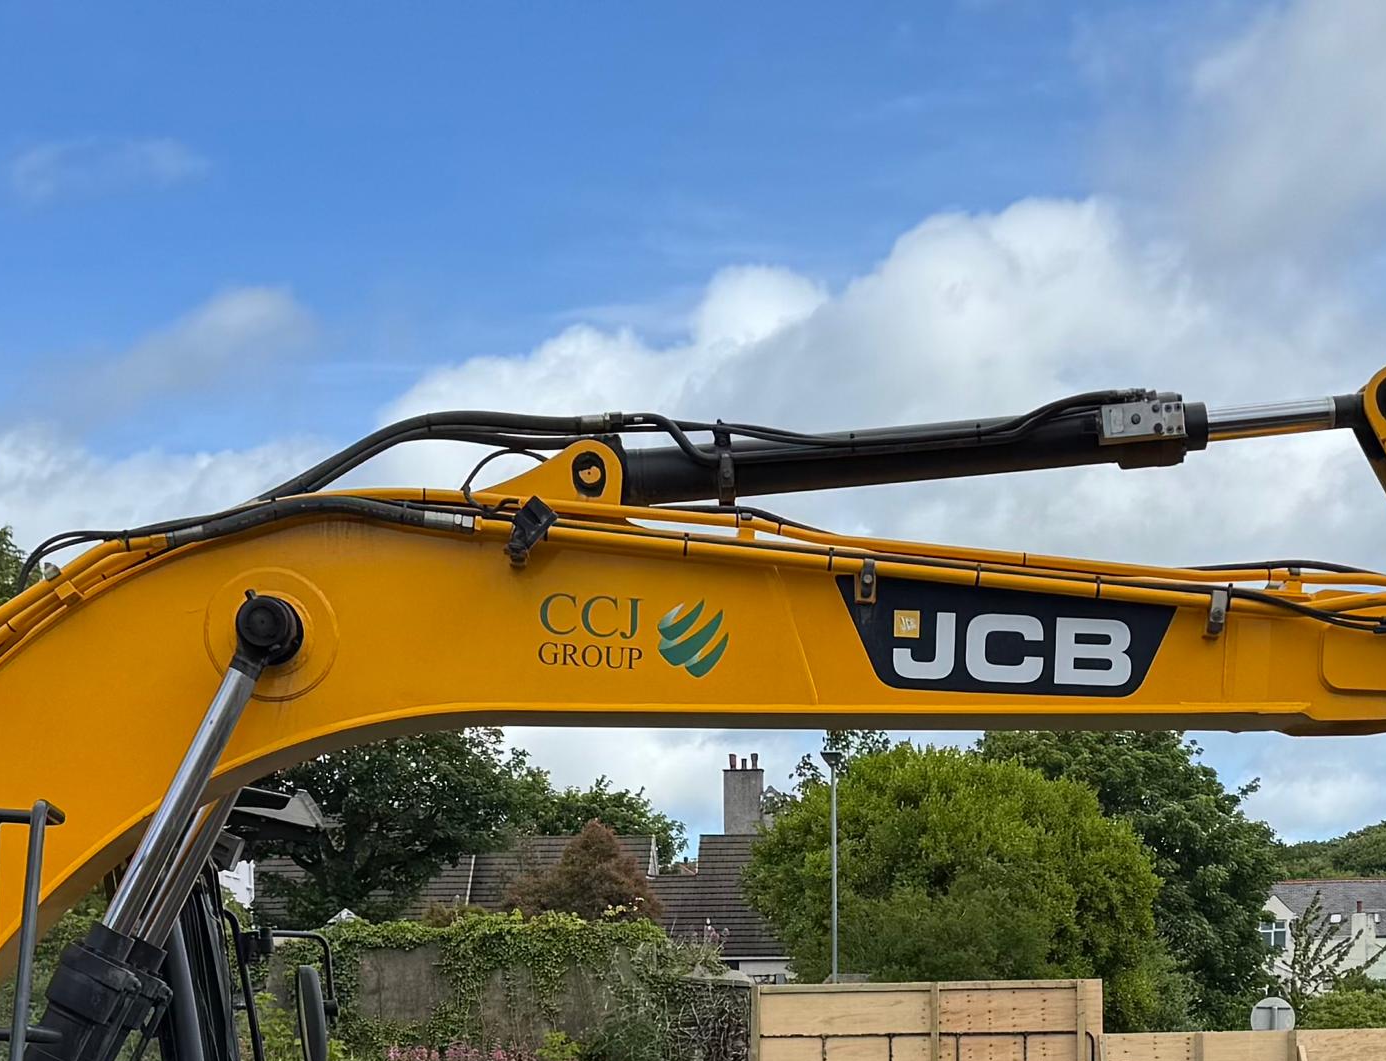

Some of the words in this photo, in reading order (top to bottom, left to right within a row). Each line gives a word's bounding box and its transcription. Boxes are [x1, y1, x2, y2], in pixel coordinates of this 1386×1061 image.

[539, 593, 644, 639] CCJ
[538, 642, 643, 669] GROUP
[893, 612, 1133, 687] JCB
